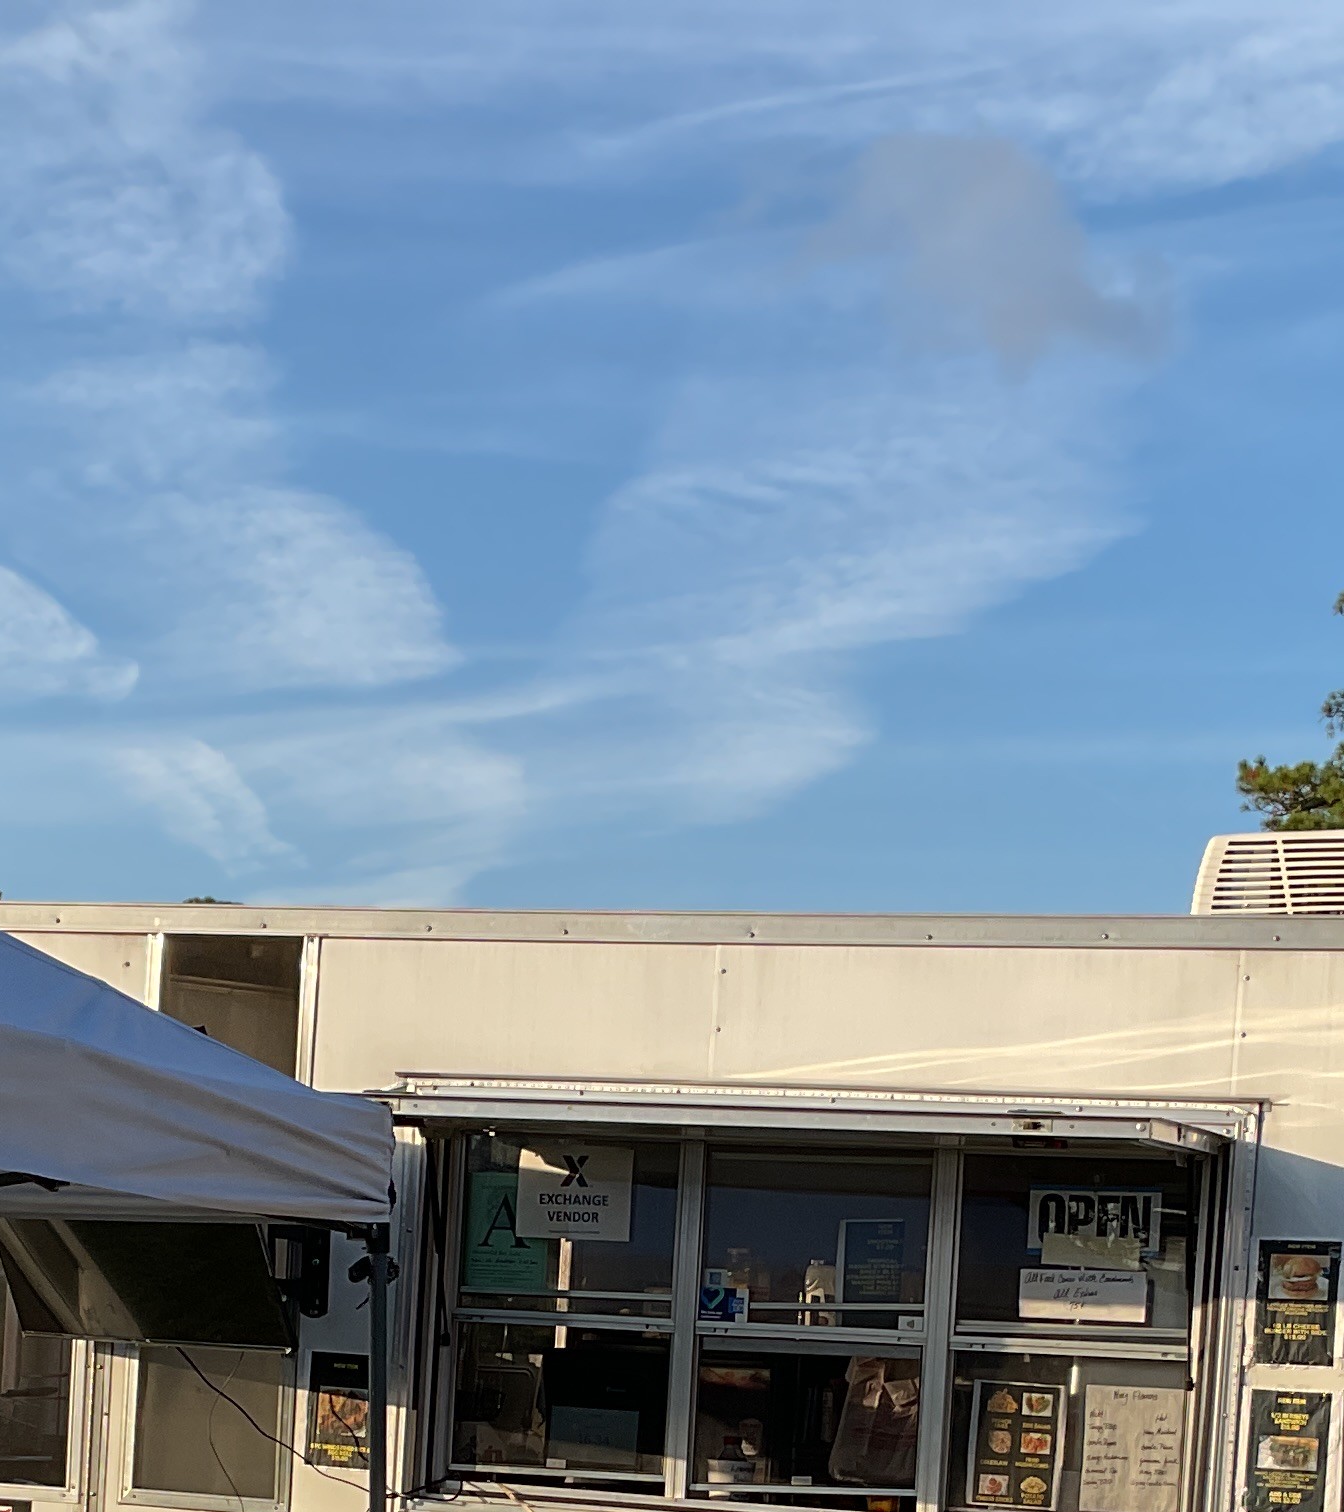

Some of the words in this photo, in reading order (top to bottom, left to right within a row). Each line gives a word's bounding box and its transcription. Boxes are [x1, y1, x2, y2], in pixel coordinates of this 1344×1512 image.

[539, 1194, 608, 1207] EXCHANGE
[478, 1193, 531, 1248] A
[547, 1211, 599, 1223] VENDOR
